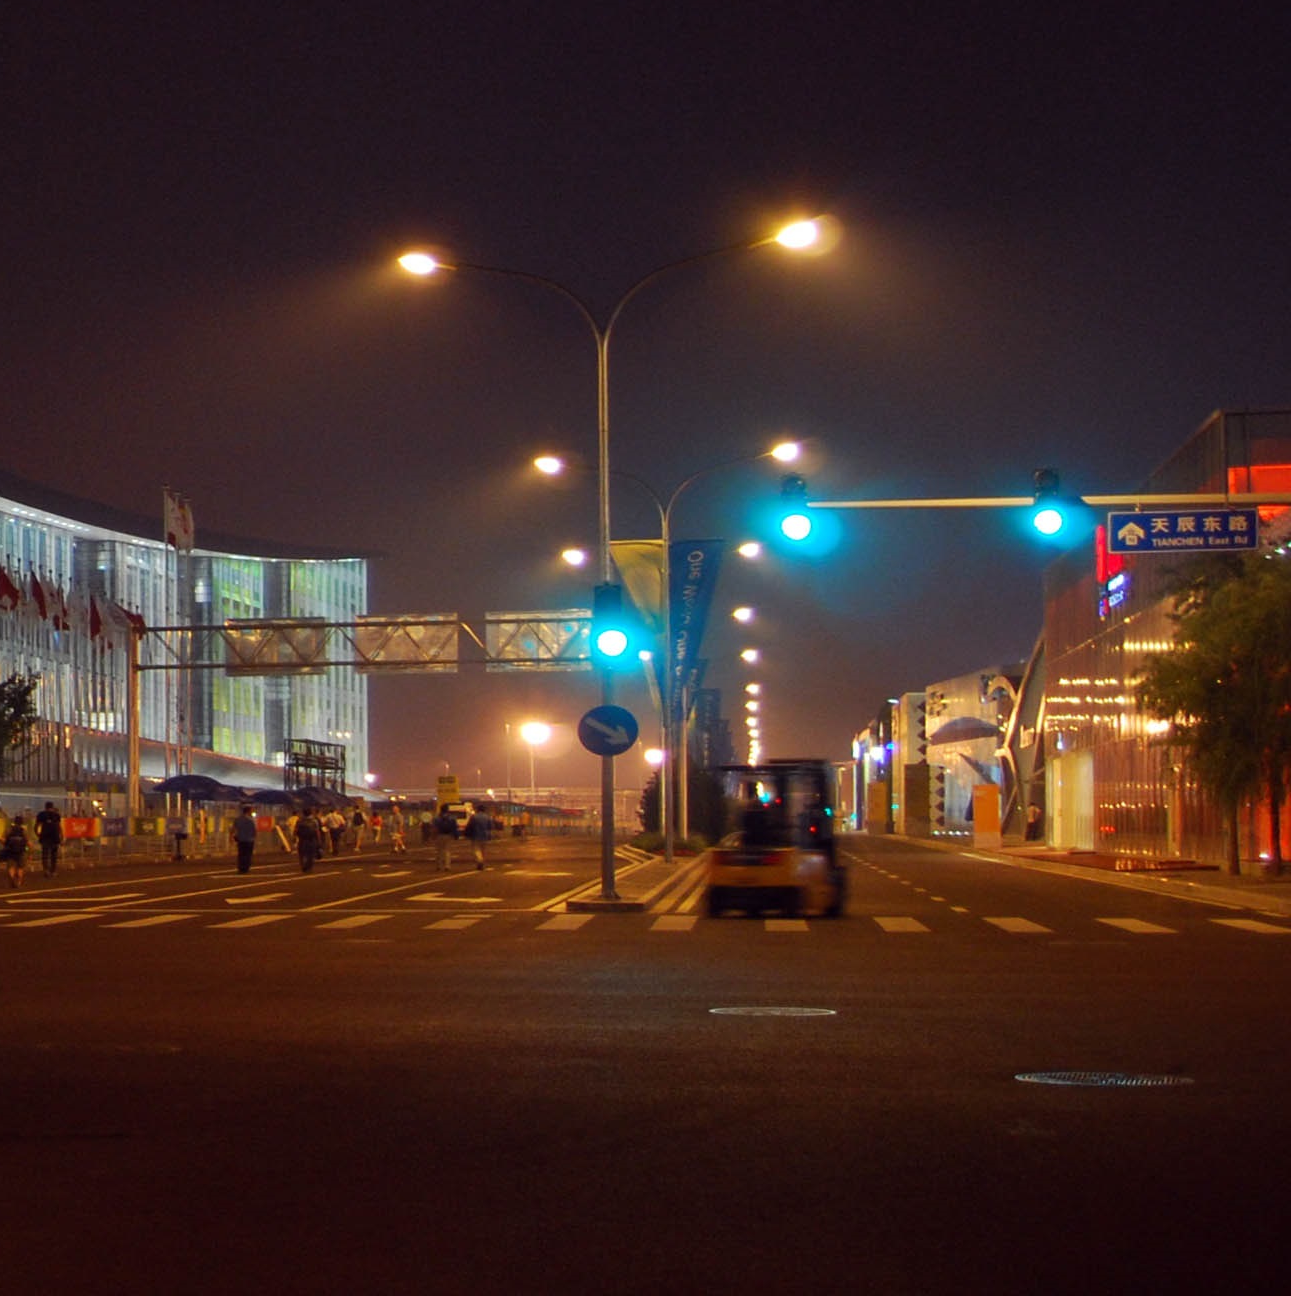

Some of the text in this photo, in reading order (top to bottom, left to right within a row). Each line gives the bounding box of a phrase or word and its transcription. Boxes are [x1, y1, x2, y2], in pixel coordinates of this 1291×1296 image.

[1150, 516, 1248, 533] 天辰东路
[1151, 536, 1204, 547] TIANCHEN
[1209, 535, 1230, 545] East
